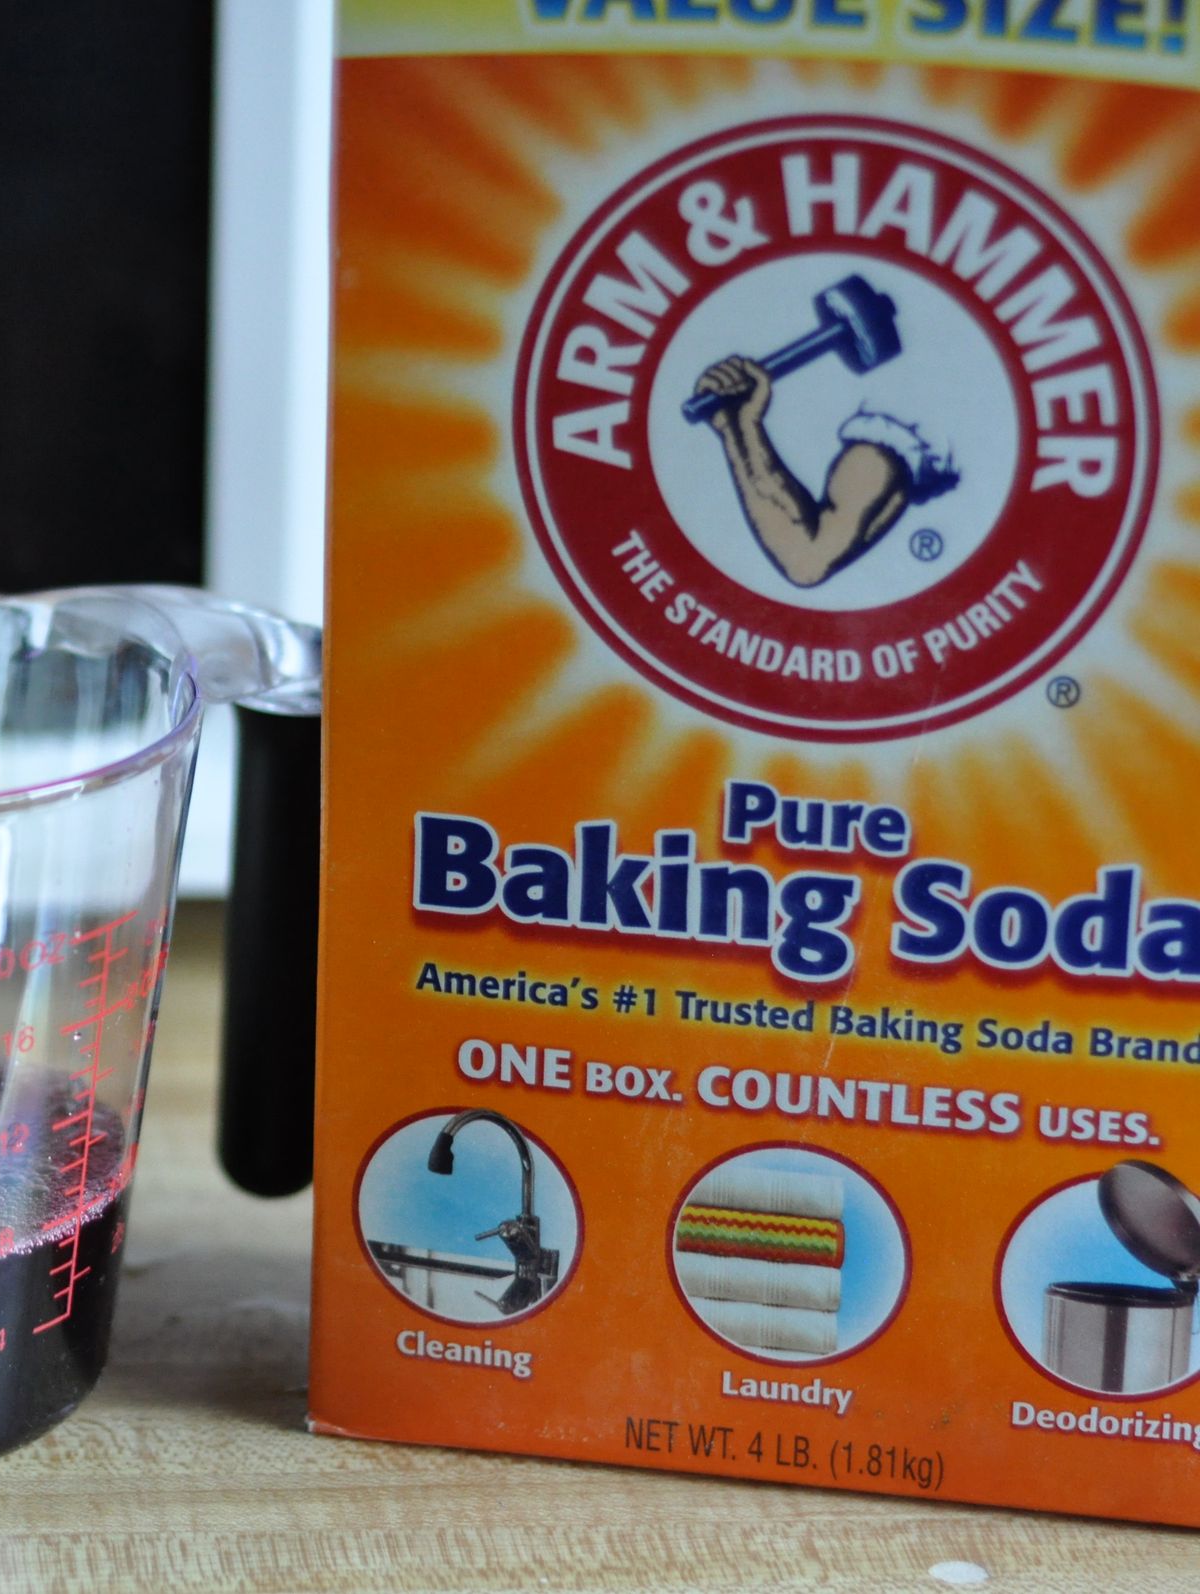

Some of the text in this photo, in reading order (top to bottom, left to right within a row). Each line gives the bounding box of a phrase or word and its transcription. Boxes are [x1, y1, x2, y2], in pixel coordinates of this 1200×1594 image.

[553, 153, 1119, 497] ARM & HAMMER
[611, 529, 1043, 682] THE STANDARD OF PURITY
[724, 778, 910, 857] Pure
[413, 811, 1200, 983] Baking Soda
[613, 984, 656, 1016] #1
[676, 990, 814, 1033] Trusted
[830, 1005, 962, 1054] Baking
[976, 1018, 1073, 1054] Soda
[1089, 1027, 1200, 1064] Brand
[458, 1039, 1160, 1145] ONE BOX. COUNTLESS USES.
[396, 1330, 533, 1378] Cleaning
[722, 1371, 853, 1414] Laundry
[625, 1416, 945, 1491] NET WT. 4 LB. (1.81kg)
